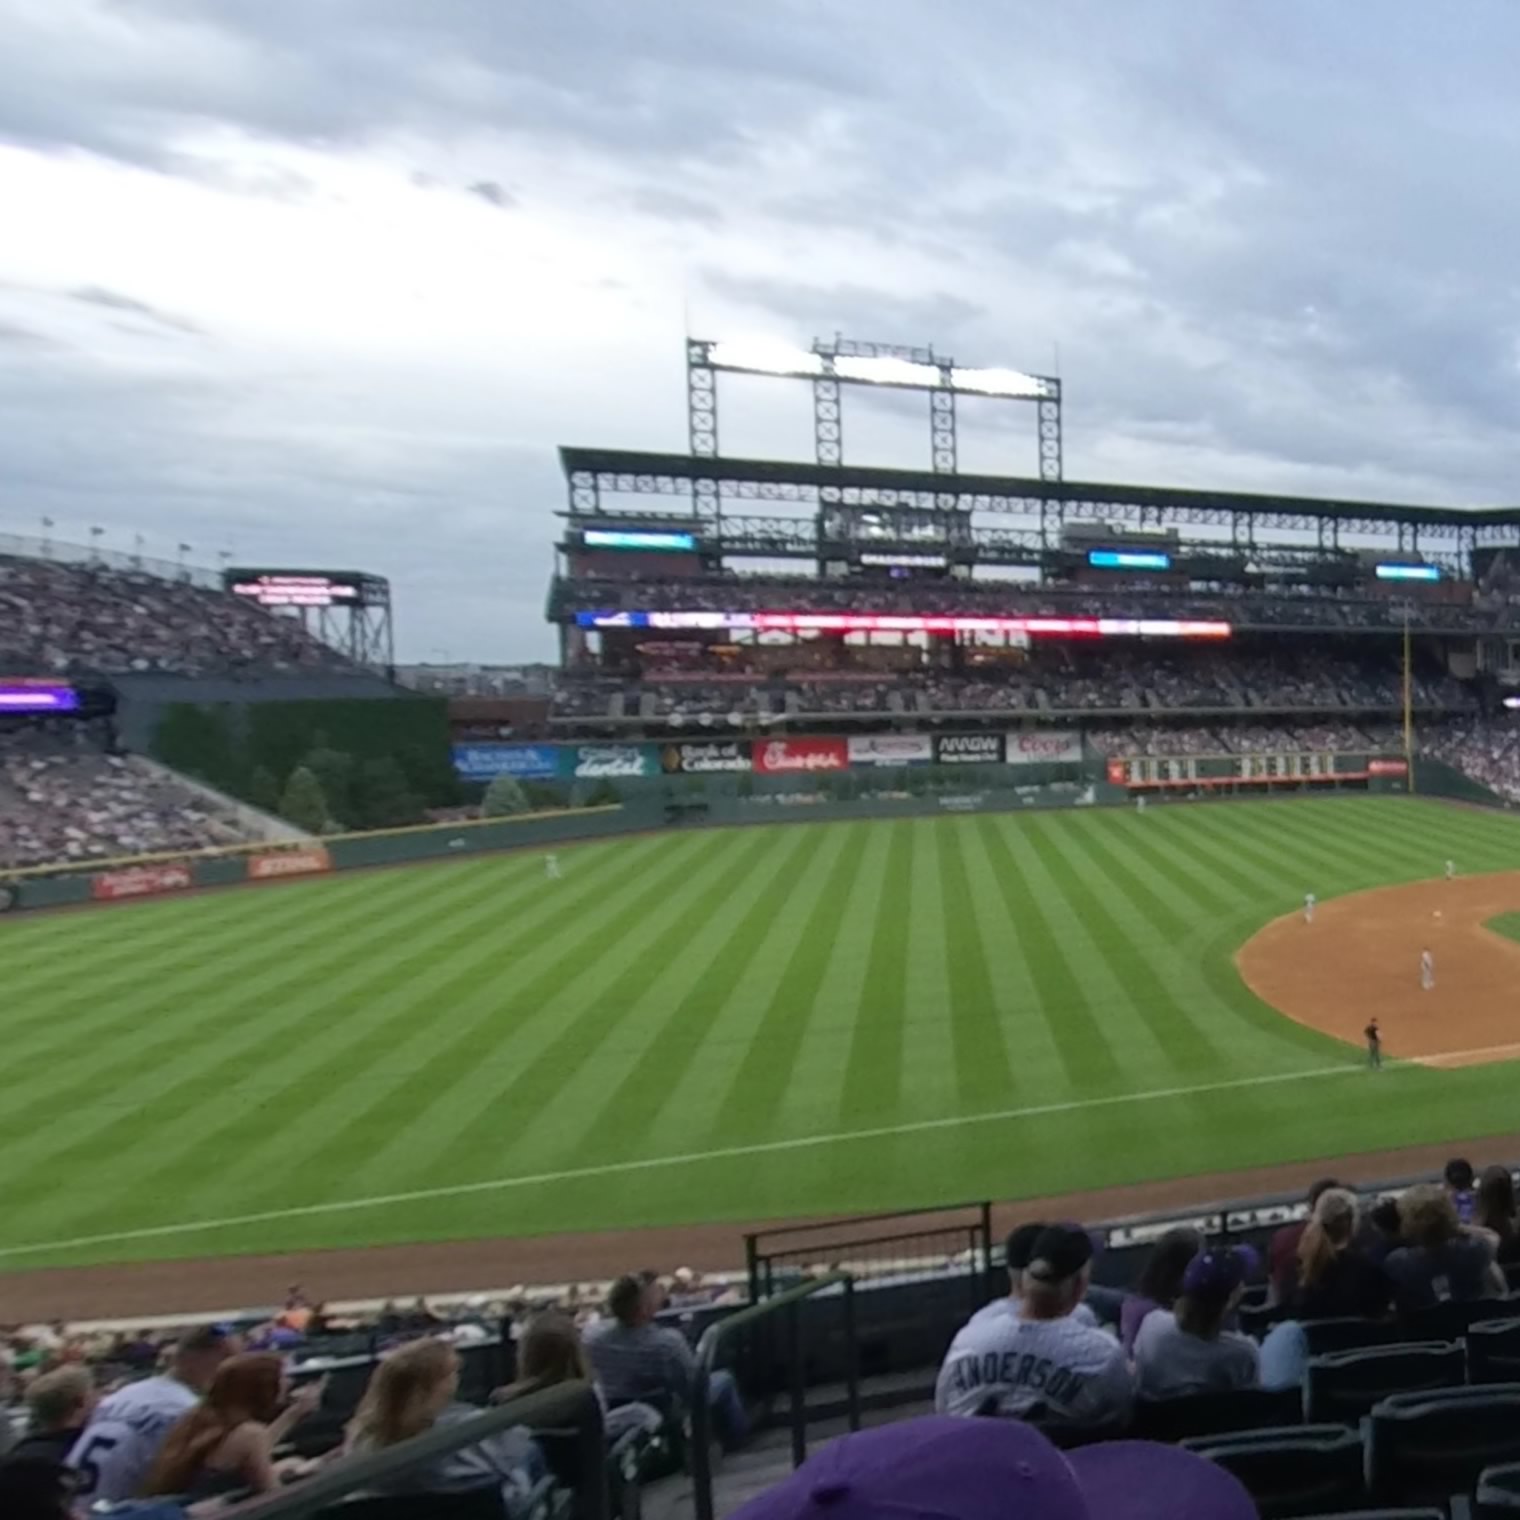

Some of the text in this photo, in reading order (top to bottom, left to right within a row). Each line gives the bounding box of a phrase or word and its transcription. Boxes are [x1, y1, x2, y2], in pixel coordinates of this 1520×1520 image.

[939, 736, 998, 752] ARROW
[574, 756, 645, 777] dental
[682, 755, 751, 771] Colorado
[954, 1351, 1084, 1402] ANDERSON
[72, 1436, 117, 1495] 5
